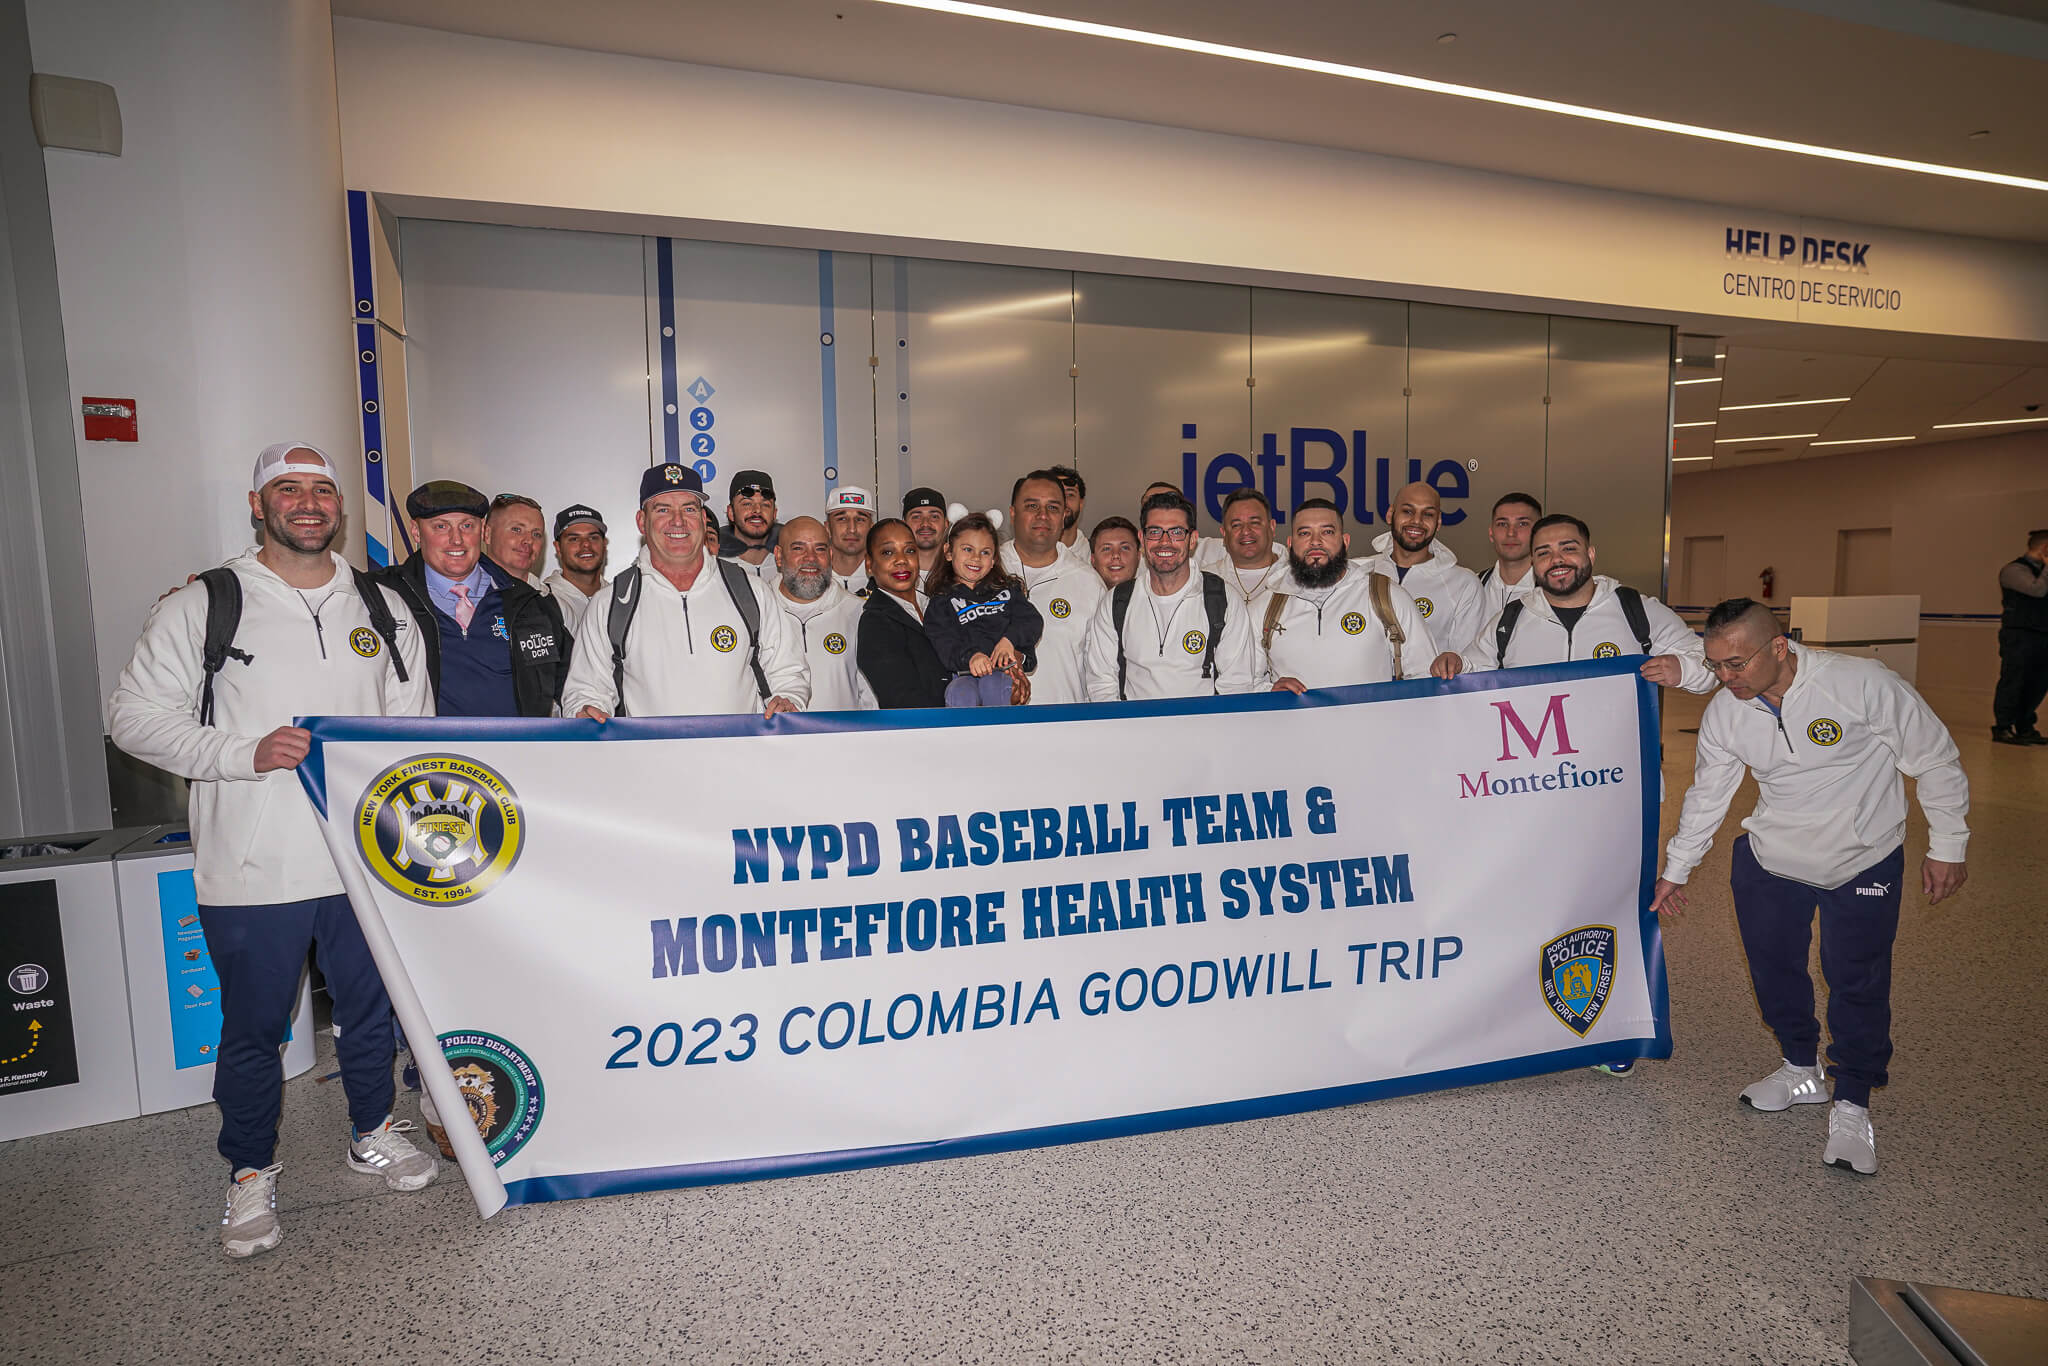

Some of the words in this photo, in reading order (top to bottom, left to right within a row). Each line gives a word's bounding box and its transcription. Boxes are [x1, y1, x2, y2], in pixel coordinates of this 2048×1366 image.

[1725, 227, 1796, 264] HELP
[1802, 237, 1871, 275] DESK
[1723, 272, 1795, 301] CENTRO
[1801, 280, 1823, 303] DE
[1827, 283, 1902, 311] SERVICIO
[695, 382, 708, 397] A
[697, 411, 708, 427] 3
[698, 437, 709, 453] 2
[699, 463, 707, 479] 1
[958, 604, 1006, 625] SOCCER
[519, 635, 554, 652] POLICE
[531, 648, 549, 658] DCPI
[1456, 761, 1624, 799] Montefiore
[362, 800, 378, 826] NEW
[374, 773, 402, 798] YORK
[401, 761, 447, 778] FINEST
[449, 762, 503, 797] BASEBALL
[500, 796, 517, 825] CLUB
[416, 821, 466, 836] FINEST
[732, 821, 881, 884] NYPD
[895, 801, 1149, 873] BASEBALL
[1162, 789, 1293, 847] TEAM
[1305, 786, 1337, 835] &
[413, 887, 439, 900] EST.
[443, 885, 473, 900] 1994
[1855, 887, 1884, 897] PUMA
[650, 890, 1006, 979] MONTEFIORE
[1021, 872, 1207, 940] HEALTH
[1219, 853, 1415, 920] SYSTEM
[1546, 938, 1568, 956] PORT
[1568, 930, 1612, 945] AUTHORITY
[1549, 940, 1608, 968] POLICE
[605, 1013, 759, 1069] 2023
[779, 977, 1060, 1056] COLOMBIA
[1079, 948, 1332, 1017] GOODWILL
[1347, 935, 1463, 985] TRIP
[1544, 979, 1557, 999] NEW
[1553, 1000, 1576, 1023] YORK
[1582, 1001, 1601, 1023] NEW
[1596, 962, 1613, 1001] JERSEY
[12, 999, 55, 1012] Waste
[446, 1036, 485, 1047] POLICE
[485, 1039, 537, 1088] DEPARTMENT
[11, 1070, 48, 1082] Kennedy
